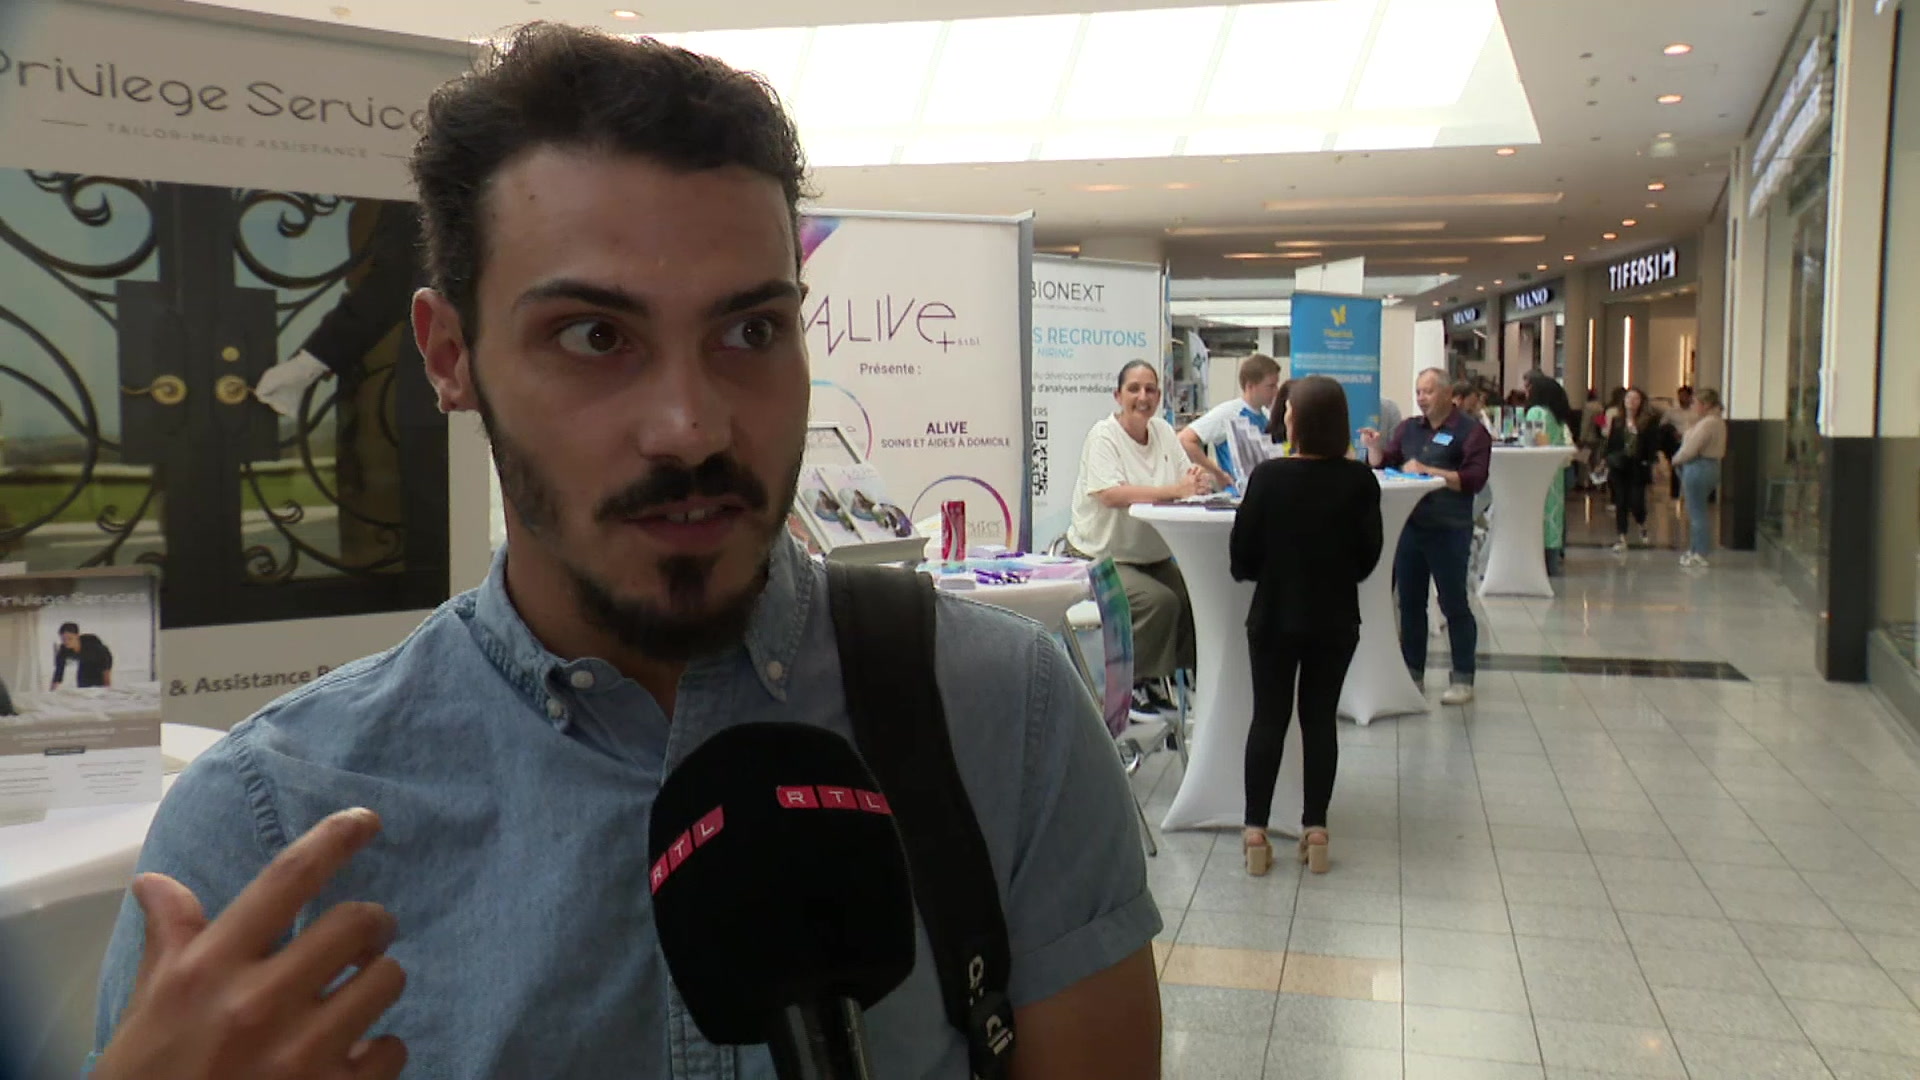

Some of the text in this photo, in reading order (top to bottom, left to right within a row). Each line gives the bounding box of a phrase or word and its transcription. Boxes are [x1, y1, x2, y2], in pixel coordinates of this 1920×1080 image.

[106, 122, 368, 158] TAILOR-MADE ASSISTANCE
[1609, 253, 1660, 291] TIFFOSI
[1515, 288, 1549, 310] MANO
[1048, 327, 1147, 348] RECRUTONS
[926, 421, 968, 434] ALIVE
[881, 438, 911, 448] SOINS
[913, 438, 924, 448] ET
[928, 438, 955, 448] AIDES
[967, 437, 1010, 447] DOMICILE
[169, 680, 187, 697] &
[194, 669, 311, 695] Assistance
[786, 790, 882, 810] RTL
[652, 822, 716, 880] RTL
